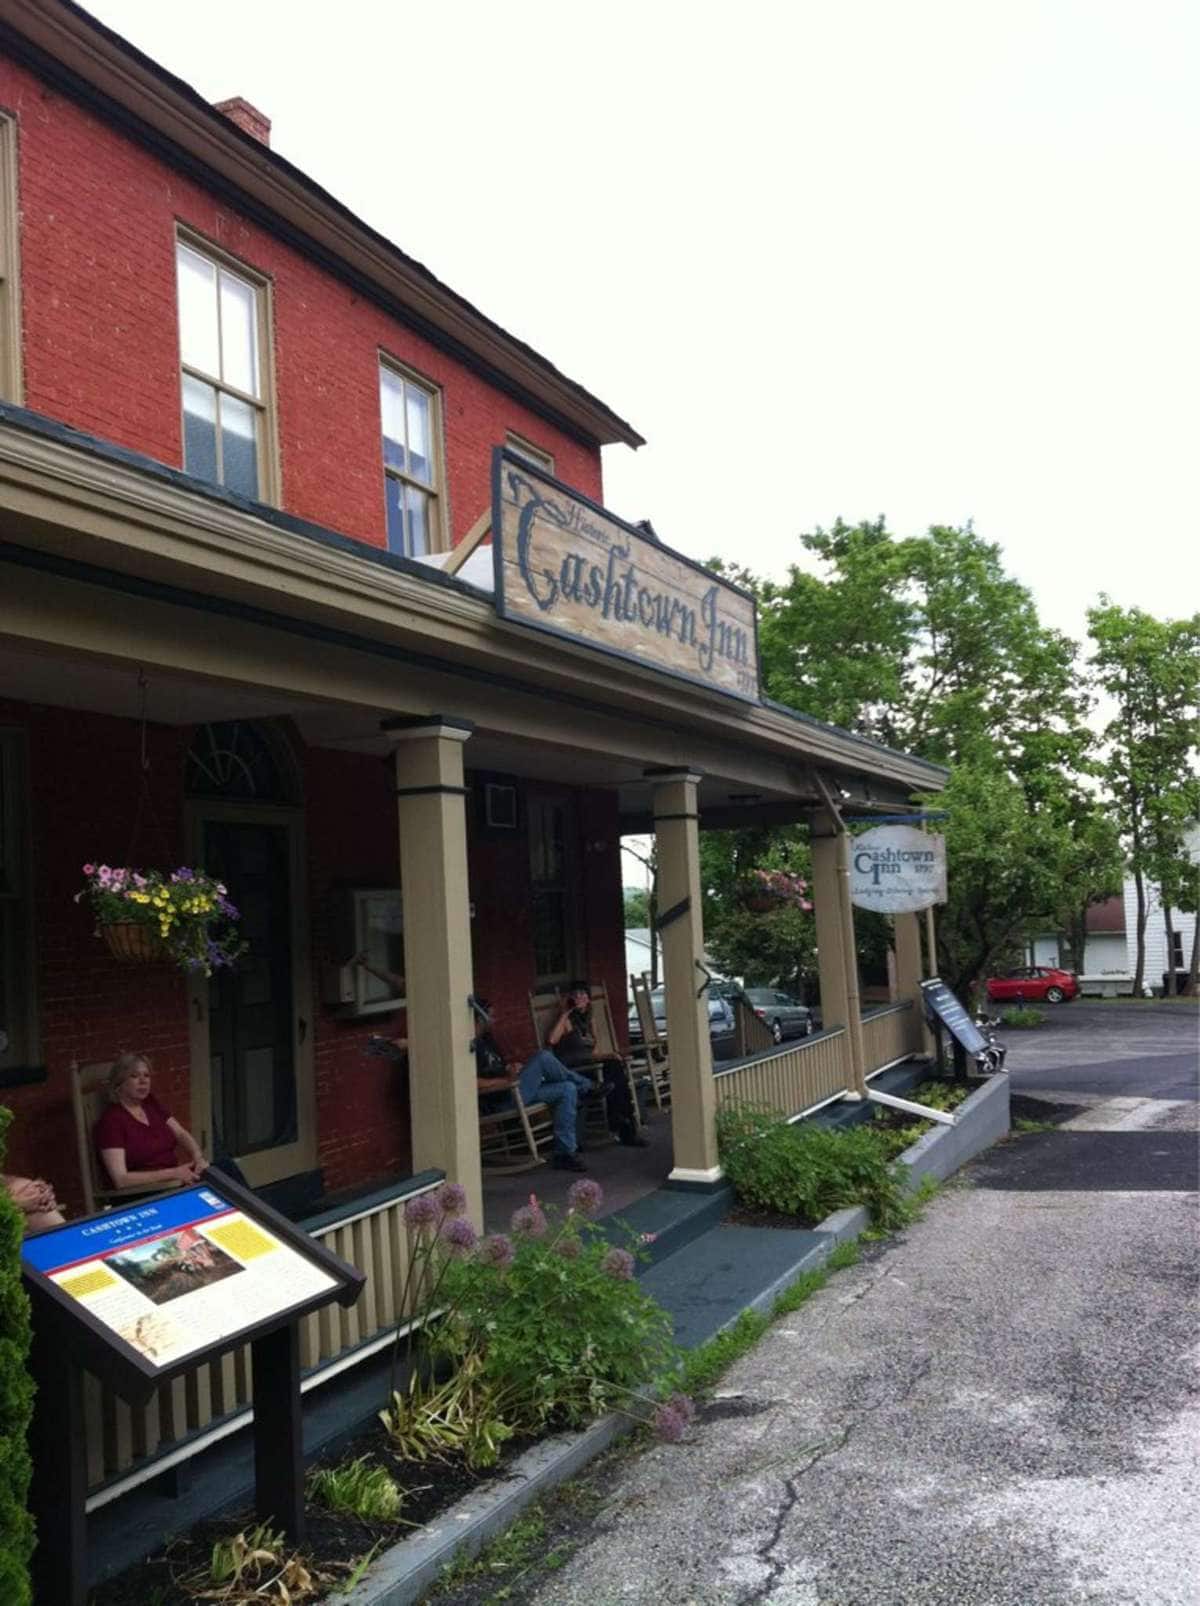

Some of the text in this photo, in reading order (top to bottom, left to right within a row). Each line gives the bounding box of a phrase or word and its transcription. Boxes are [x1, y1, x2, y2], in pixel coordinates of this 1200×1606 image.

[507, 471, 749, 672] Cashtown Inn
[854, 847, 934, 874] Cashtown
[871, 862, 902, 886] Inn
